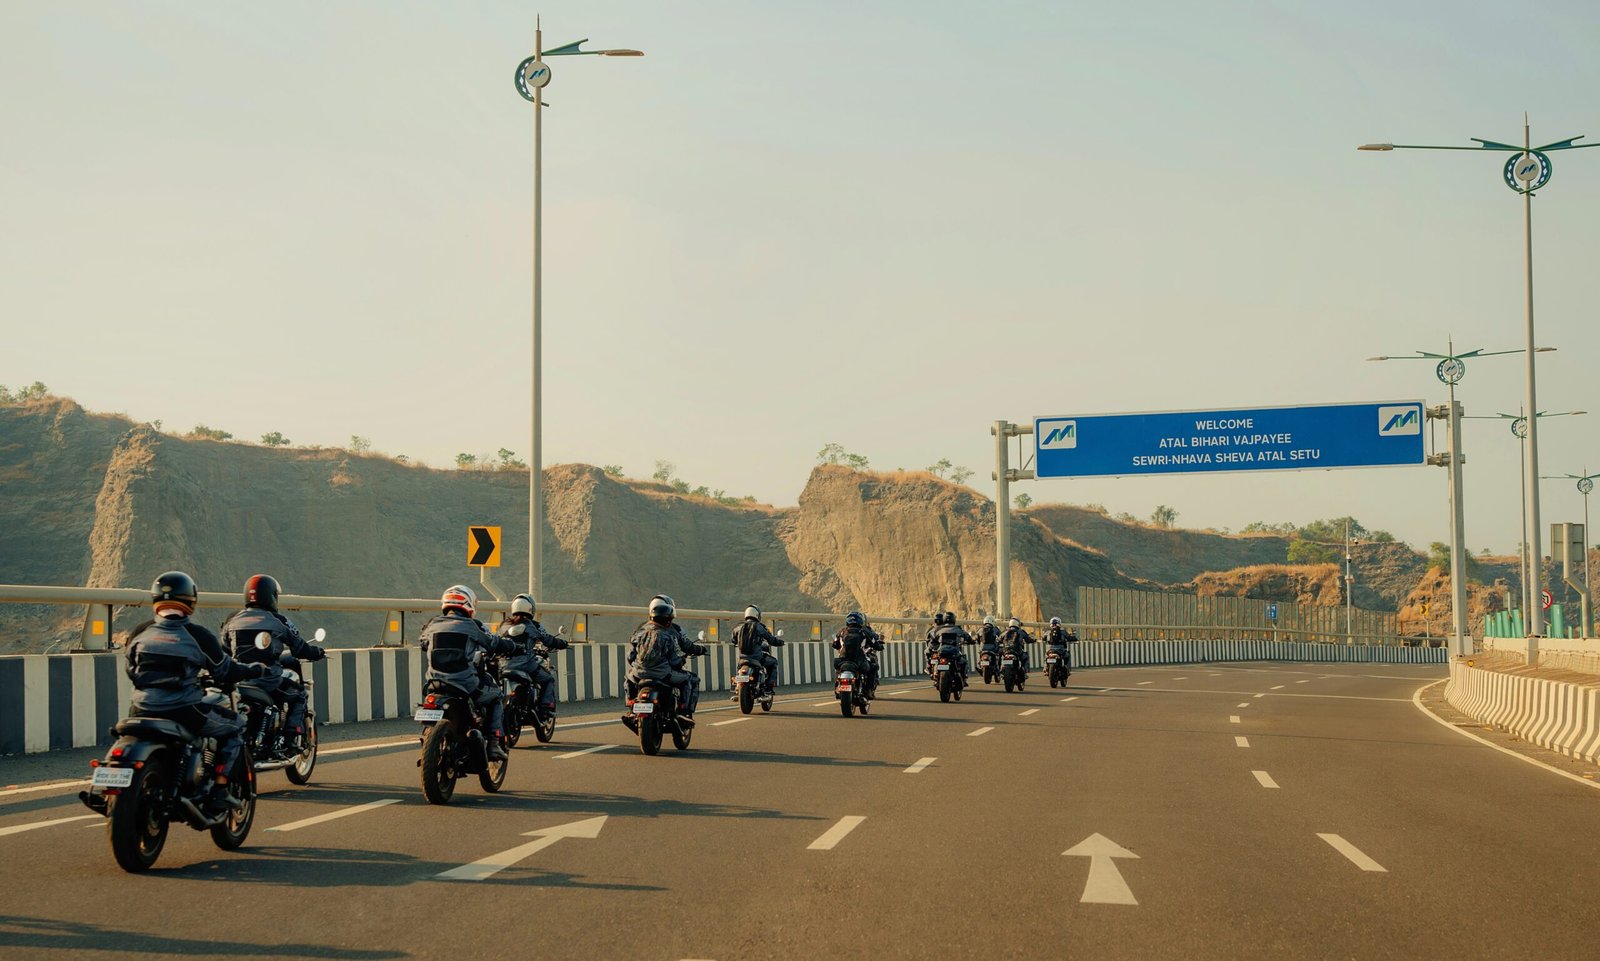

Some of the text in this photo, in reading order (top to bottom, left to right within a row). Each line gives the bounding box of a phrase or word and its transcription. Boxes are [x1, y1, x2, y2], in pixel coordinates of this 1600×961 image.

[1195, 419, 1254, 430] WELCOME
[1159, 433, 1292, 448] ATAL BIHARI VAJPAYEE
[1132, 449, 1320, 466] SEWRI-NHAVA SHEVA ATAL SETU
